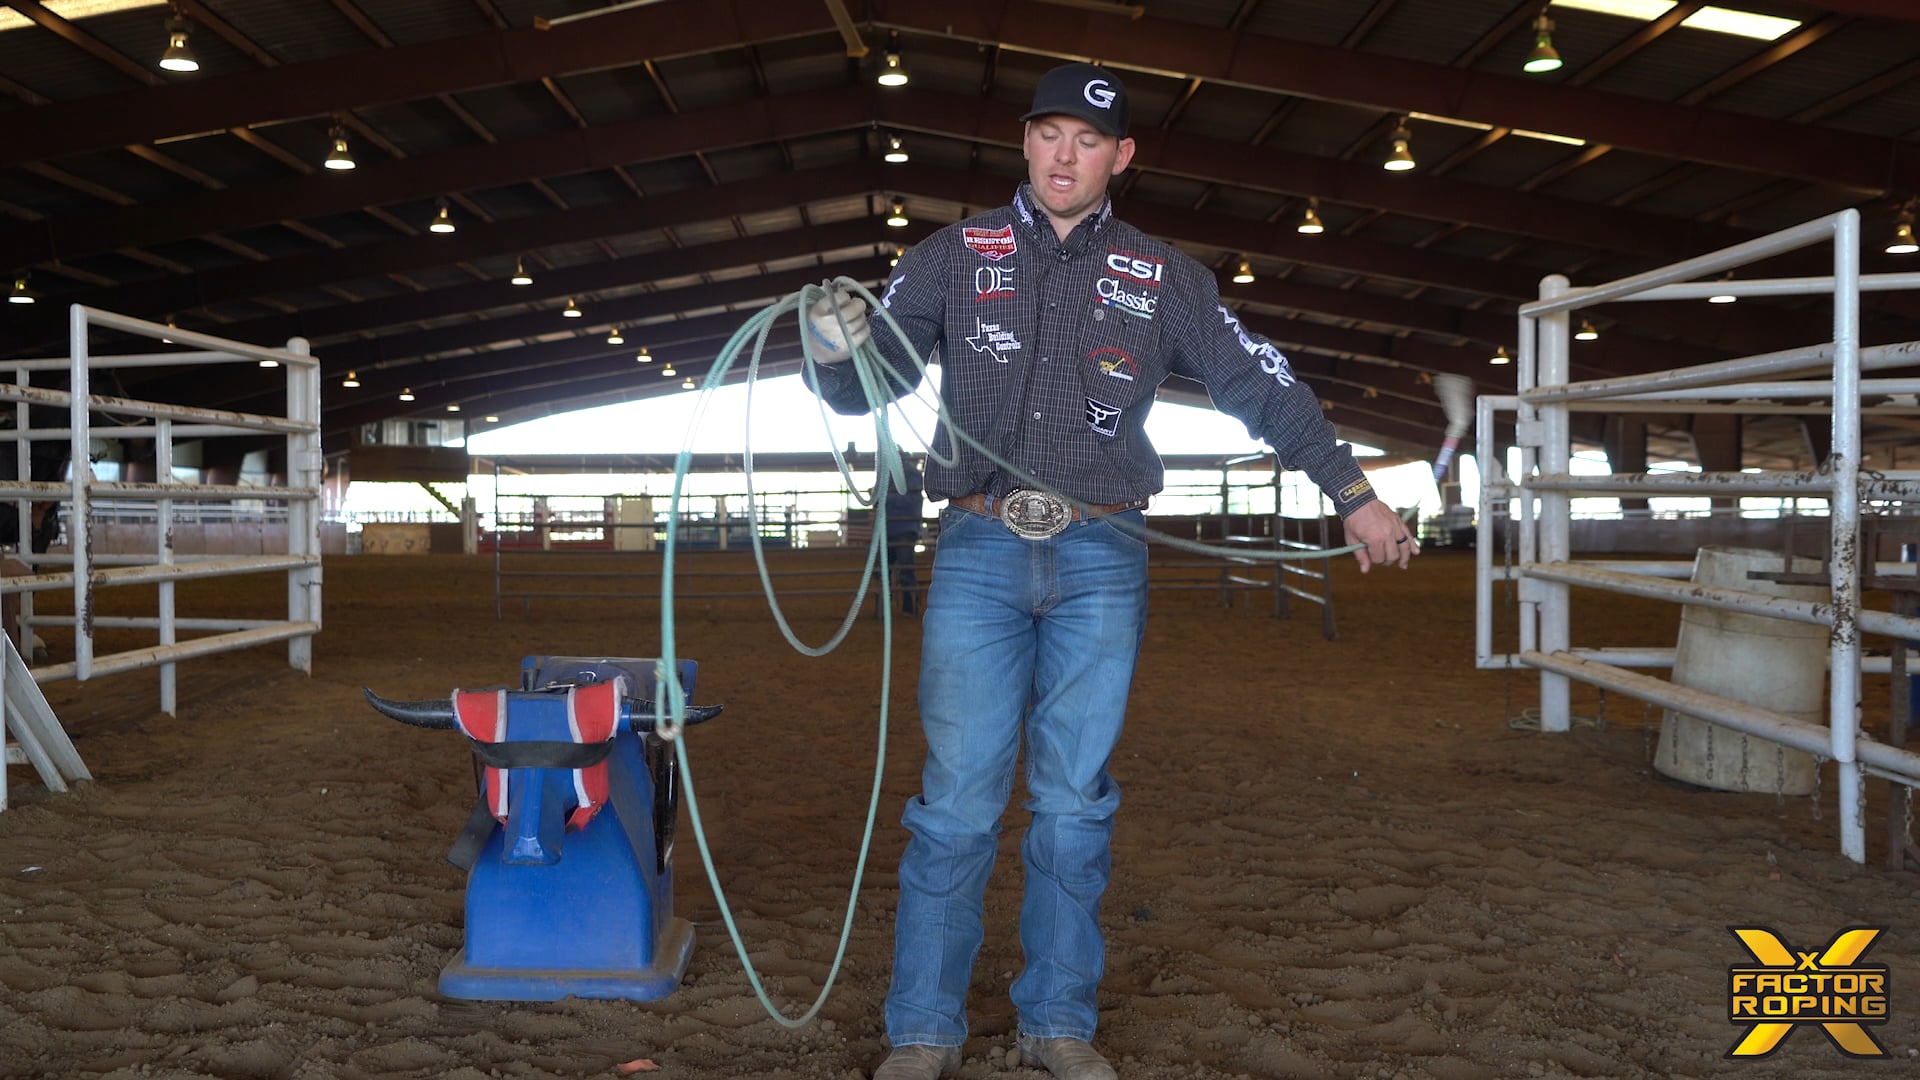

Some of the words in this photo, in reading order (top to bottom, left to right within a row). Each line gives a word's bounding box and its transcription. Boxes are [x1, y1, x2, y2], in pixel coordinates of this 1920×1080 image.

[1107, 254, 1163, 281] CSI
[1097, 278, 1156, 313] Classic
[981, 323, 1000, 333] Texas
[988, 331, 1014, 342] Building
